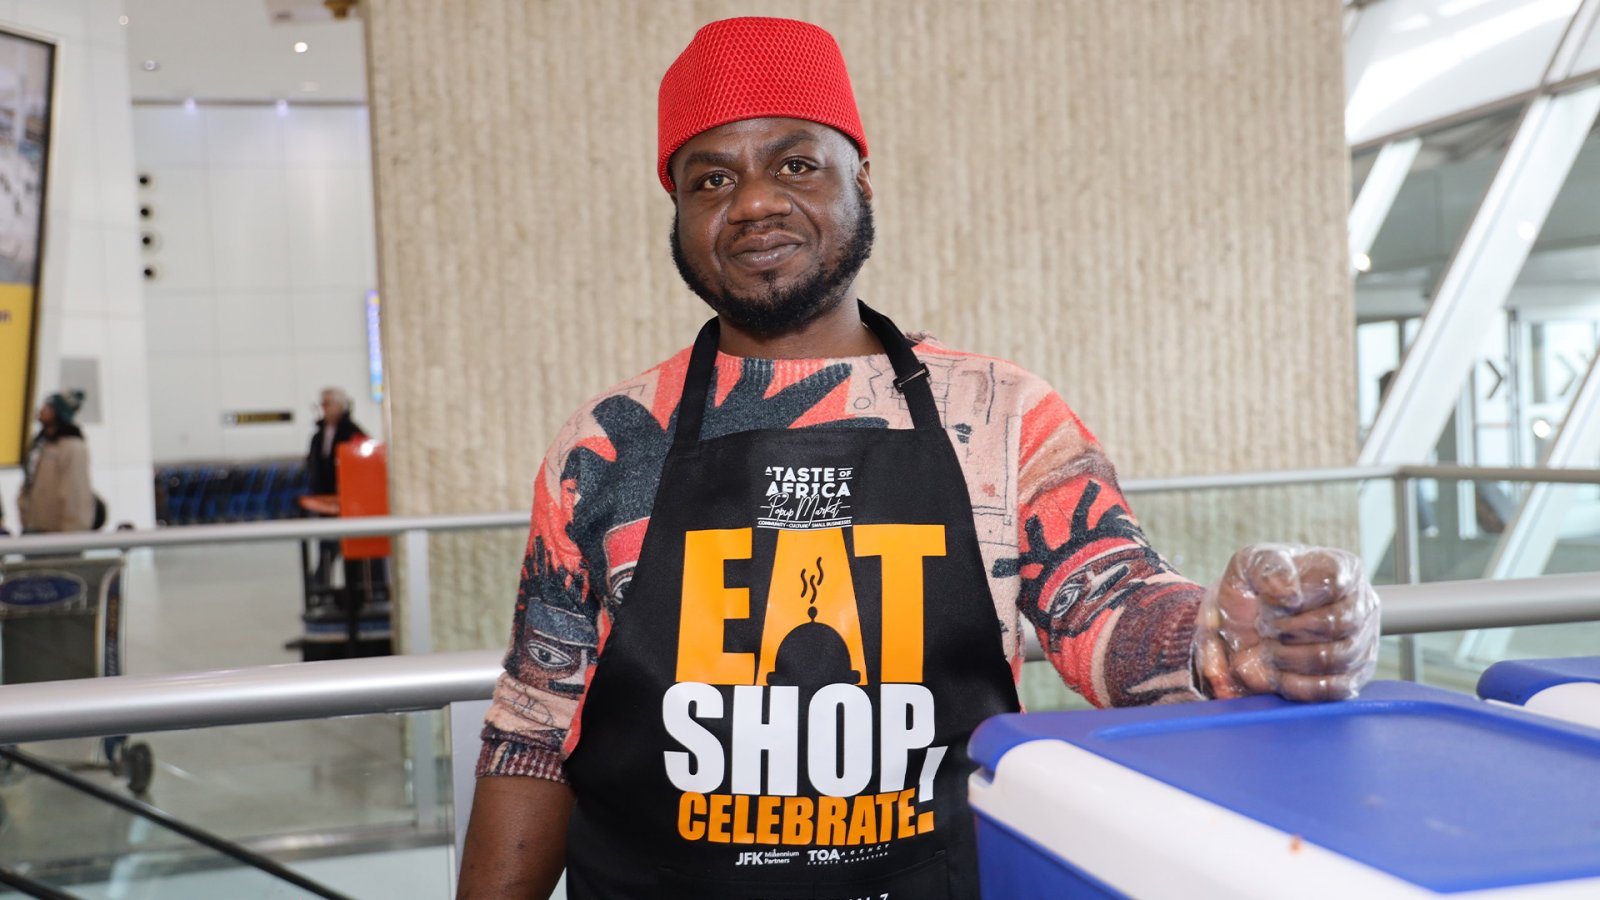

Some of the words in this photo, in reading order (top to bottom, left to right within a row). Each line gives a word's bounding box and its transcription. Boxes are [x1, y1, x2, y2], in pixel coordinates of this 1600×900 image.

[772, 466, 836, 482] TASTE
[839, 470, 852, 478] OF
[765, 481, 851, 499] AFRICA
[795, 494, 843, 527] Market
[675, 524, 947, 686] EAT
[662, 681, 935, 798] SHOP
[735, 851, 764, 866] JFK
[807, 848, 841, 861] TOA
[841, 843, 890, 857] AGENCY
[764, 848, 800, 858] Millennium
